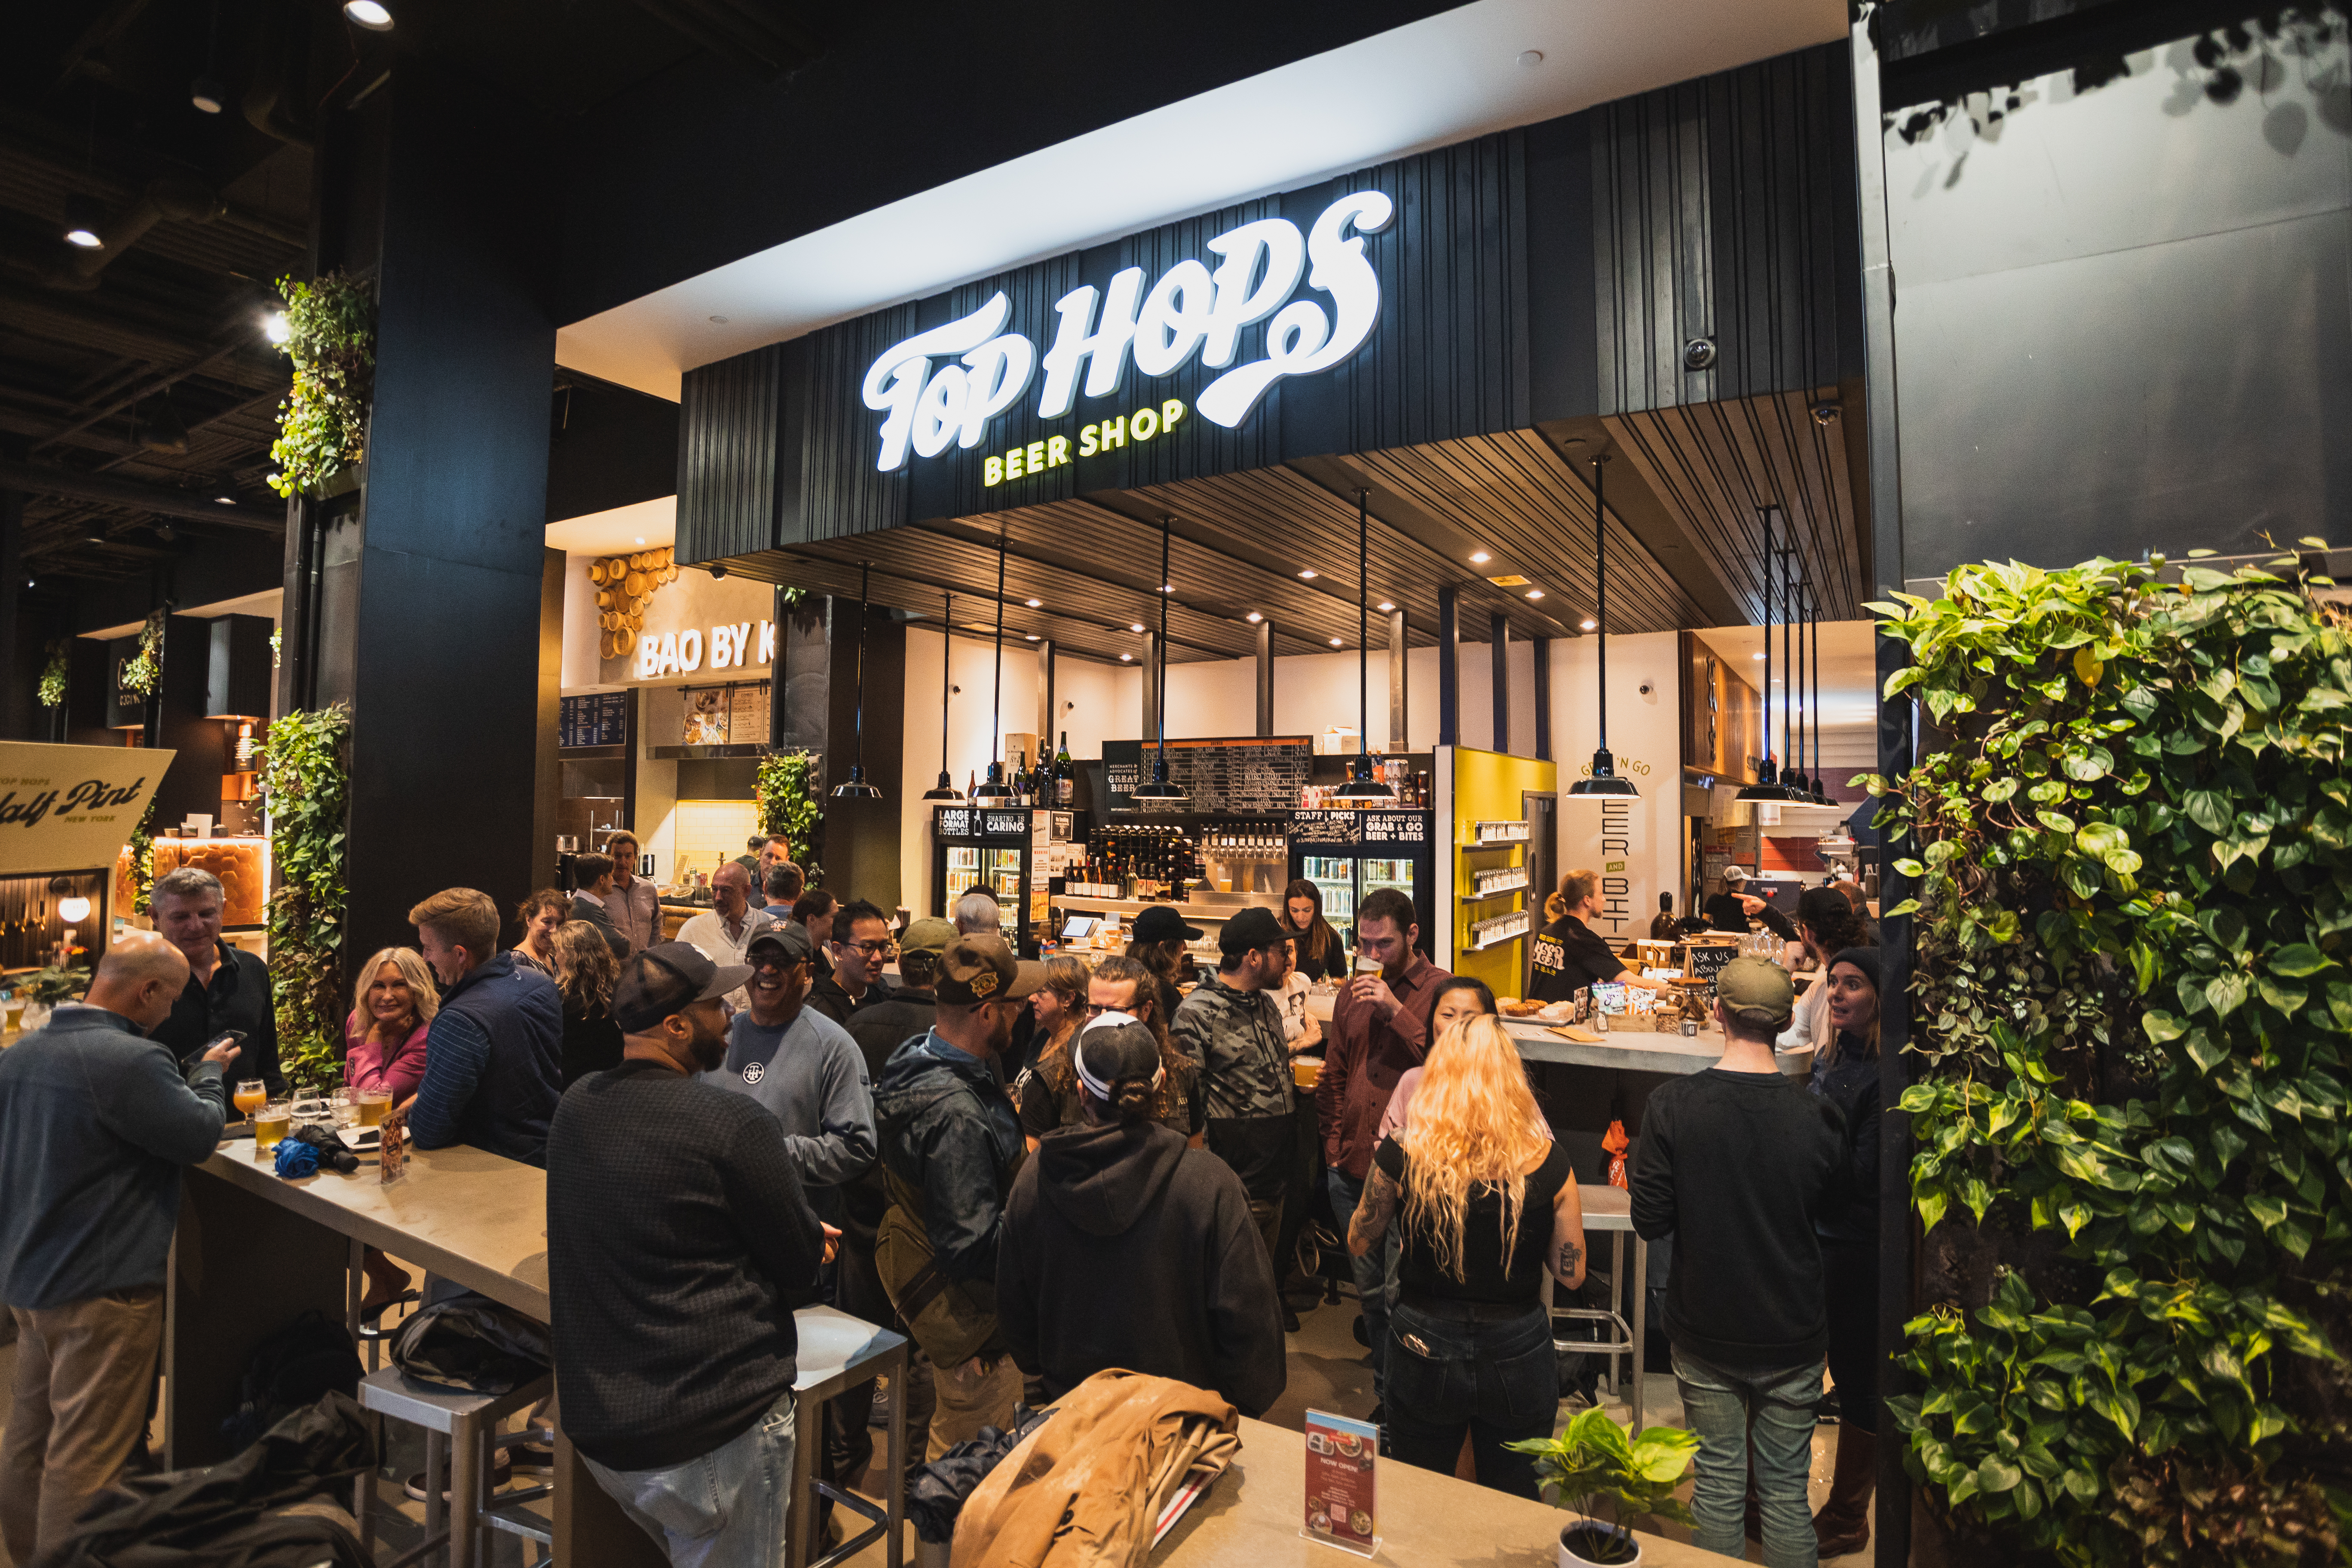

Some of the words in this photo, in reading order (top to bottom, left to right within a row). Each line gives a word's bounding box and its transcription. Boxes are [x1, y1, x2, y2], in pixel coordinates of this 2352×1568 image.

[862, 291, 1037, 472] TOP
[1038, 190, 1395, 429] HOPS
[985, 435, 1072, 487] BEER
[1079, 399, 1188, 458] SHOP
[641, 629, 702, 676] BAO
[711, 622, 751, 668] BY
[758, 619, 775, 664] K
[1632, 760, 1651, 776] GO
[1108, 775, 1139, 783] GREAT
[1111, 784, 1136, 792] BEER
[54, 777, 146, 816] Pint
[939, 810, 969, 820] LARGE
[1295, 812, 1323, 820] STAFF
[1330, 811, 1355, 820] PICKS
[939, 820, 969, 828] FORMAT
[986, 821, 1025, 832] CARING
[1366, 822, 1395, 831] GRAB
[1397, 823, 1403, 831] &
[1406, 822, 1423, 831] GO
[1602, 799, 1629, 856] EER
[1366, 832, 1388, 841] BEER
[1399, 832, 1424, 841] BITES
[1608, 863, 1623, 871] AND
[1602, 878, 1629, 954] BITE
[1692, 952, 1710, 963] ASK
[1715, 951, 1730, 963] US
[1320, 1457, 1338, 1467] NOW
